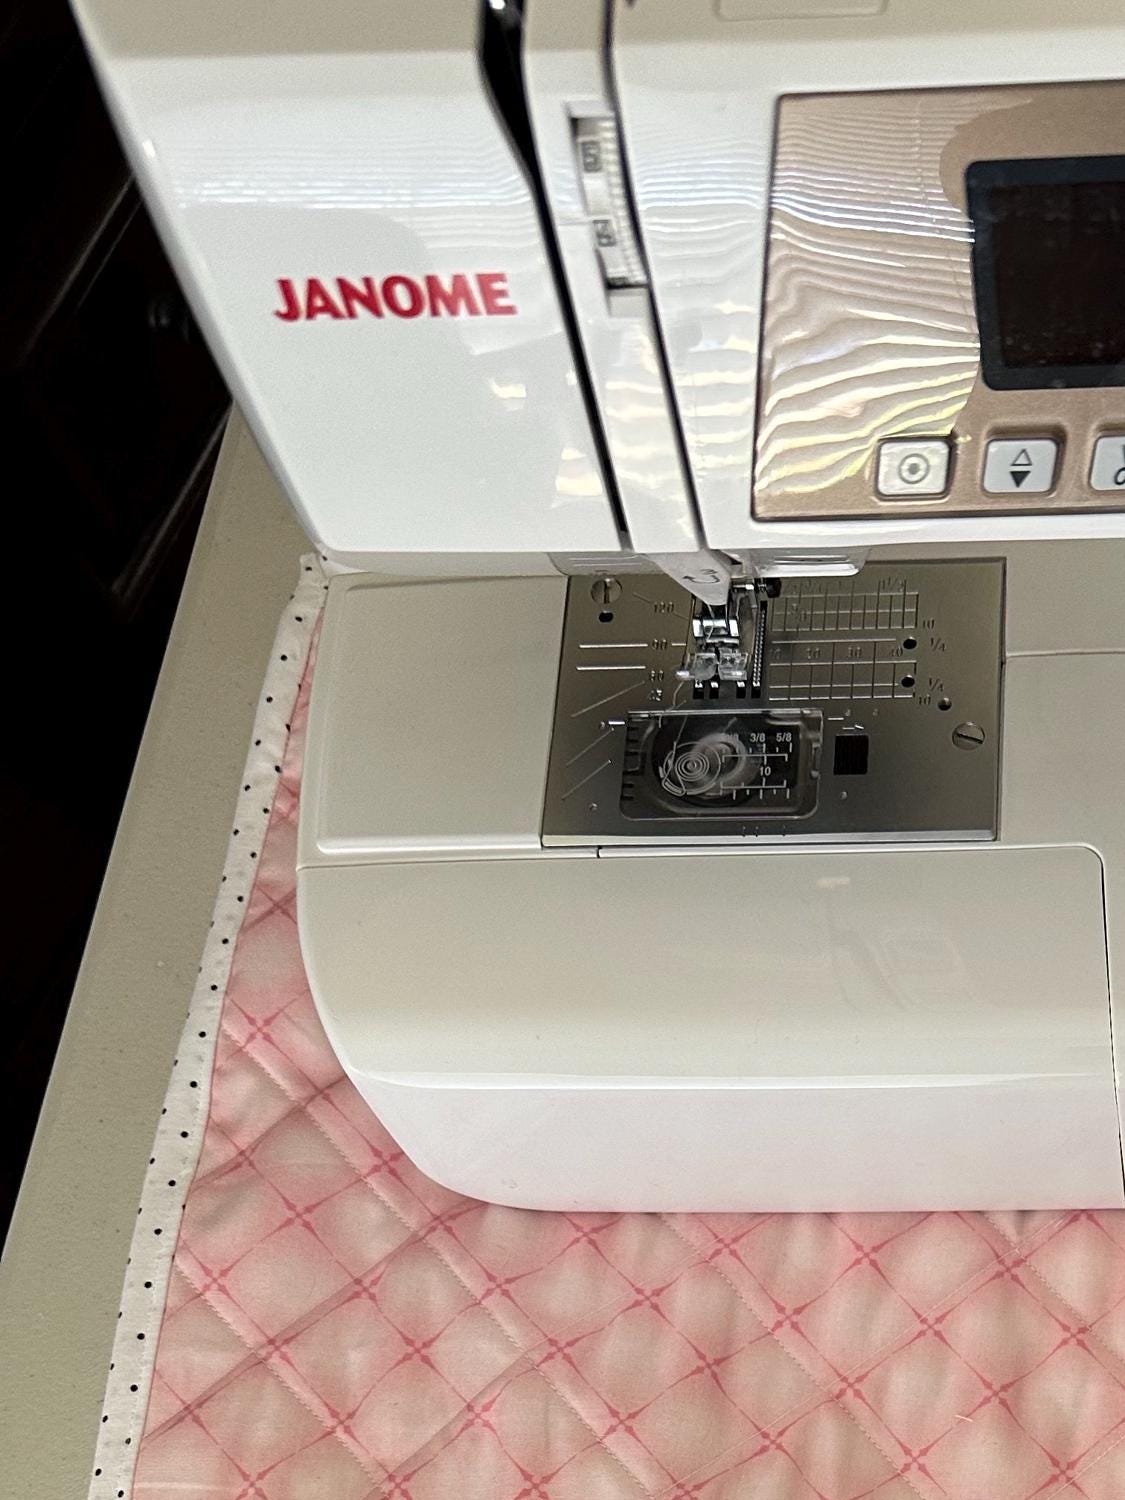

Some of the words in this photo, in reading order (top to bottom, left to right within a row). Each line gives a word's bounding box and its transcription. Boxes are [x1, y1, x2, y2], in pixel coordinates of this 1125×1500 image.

[275, 272, 517, 322] JANOME
[749, 732, 766, 743] 3/8
[775, 732, 793, 743] 5/8
[759, 765, 772, 777] 10
